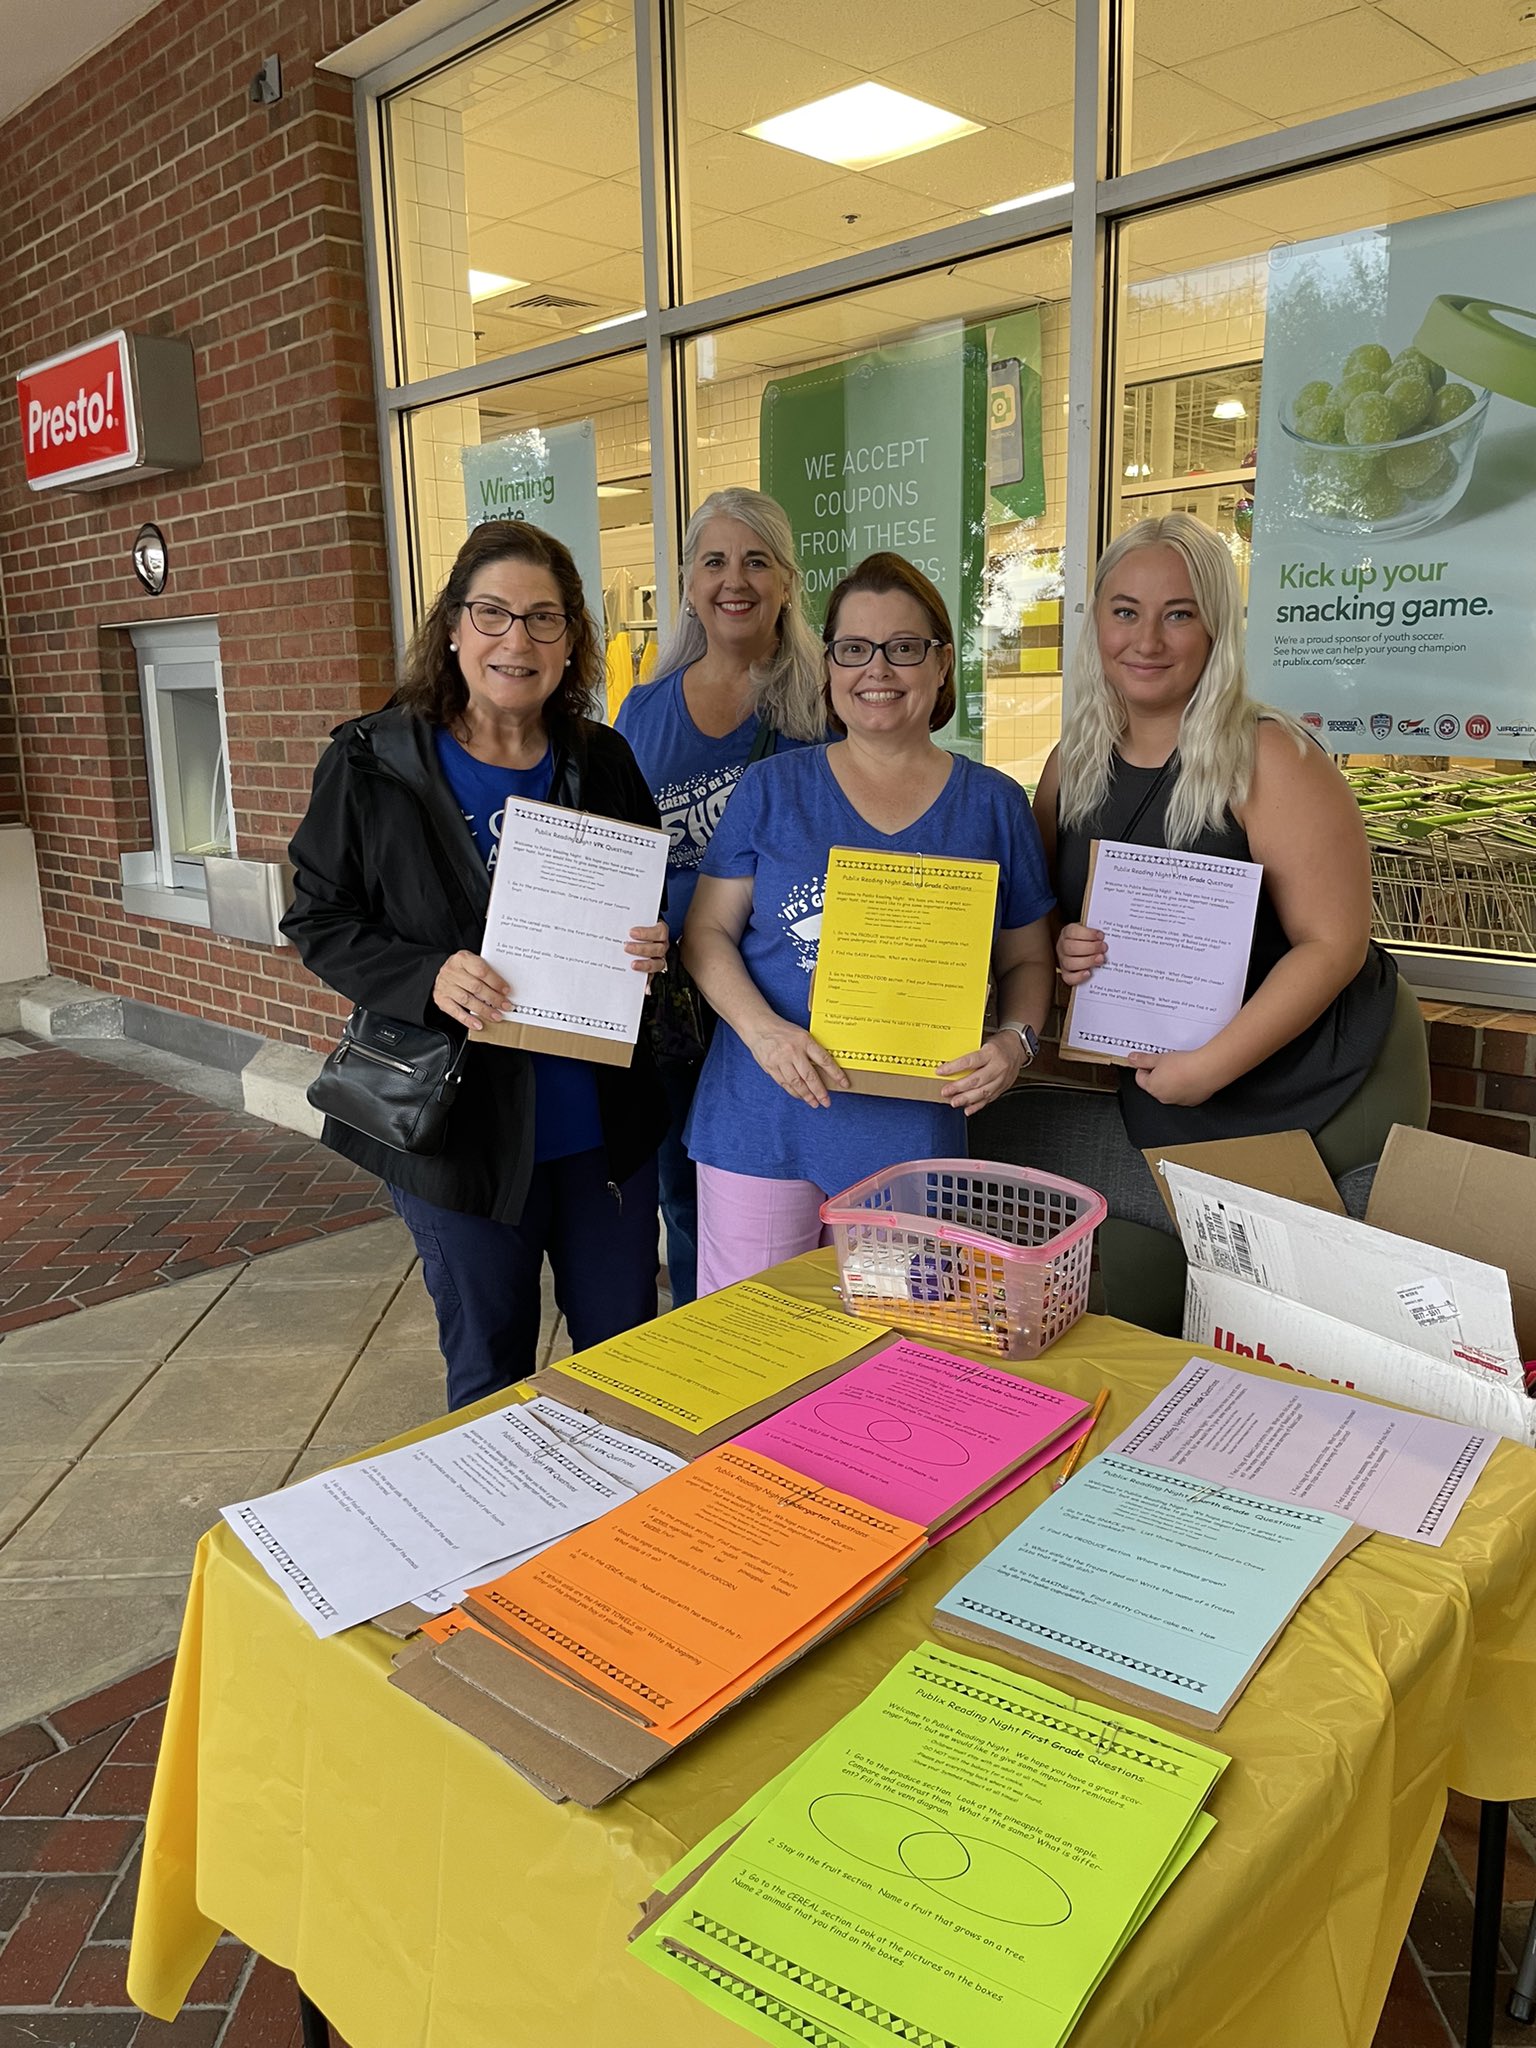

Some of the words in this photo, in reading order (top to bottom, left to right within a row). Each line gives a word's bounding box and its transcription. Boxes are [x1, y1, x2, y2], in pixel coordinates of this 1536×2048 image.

[28, 371, 114, 454] Presto!
[804, 453, 836, 481] WE
[842, 438, 929, 476] ACCEPT
[480, 471, 555, 506] Winning
[815, 480, 919, 517] COUPONS
[800, 527, 857, 556] FROM
[864, 518, 936, 549] THESE
[1280, 562, 1335, 589] Kick
[1341, 565, 1377, 593] up
[1382, 562, 1448, 592] your
[1276, 595, 1395, 627] snacking
[1401, 596, 1493, 626] game.
[1274, 635, 1298, 645] We're
[1307, 635, 1333, 646] proud
[1335, 634, 1371, 646] sponsor
[1372, 633, 1382, 643] of
[1384, 633, 1411, 644] youth
[1412, 632, 1445, 642] soccer.
[1274, 647, 1290, 656] See
[1291, 646, 1310, 655] how
[1325, 647, 1341, 655] can
[1343, 645, 1363, 656] help
[1364, 645, 1386, 656] your
[1387, 644, 1416, 655] young
[1418, 643, 1466, 653] champion
[1272, 659, 1281, 667] at
[1282, 657, 1367, 667] publix.com/soccer.
[658, 793, 691, 811] GREAT
[692, 786, 707, 799] TO
[708, 776, 724, 791] BE
[723, 771, 734, 783] A
[575, 836, 592, 846] ight
[860, 876, 883, 885] Reading
[884, 878, 901, 886] Night
[924, 881, 941, 889] Grade
[942, 883, 972, 891] Questions
[1131, 867, 1154, 877] Reading
[1154, 871, 1171, 879] Night
[1188, 875, 1205, 883] Grade
[1206, 878, 1233, 888] Questions
[783, 898, 809, 921] IT'S
[1003, 1392, 1038, 1407] Questions
[514, 1441, 536, 1457] Reading
[552, 1473, 578, 1492] Questions
[714, 1465, 735, 1478] Publix
[734, 1475, 763, 1491] Reading
[762, 1488, 784, 1501] Night
[830, 1519, 869, 1538] Questions
[1103, 1470, 1128, 1480] Publix
[1129, 1478, 1162, 1491] Reading
[1163, 1488, 1189, 1498] Night
[1188, 1495, 1220, 1508] Furth
[1222, 1505, 1249, 1516] Grade
[1254, 1514, 1301, 1529] Questions
[915, 1688, 946, 1705] Publix
[947, 1701, 987, 1723] Reading
[989, 1717, 1020, 1733] Night
[1021, 1729, 1049, 1744] First
[1051, 1741, 1084, 1758] Grade
[1087, 1755, 1144, 1782] Questions
[841, 1768, 860, 1777] ent?
[859, 1774, 874, 1784] Fill
[882, 1784, 896, 1794] the
[897, 1791, 916, 1801] venn
[916, 1799, 948, 1815] diagram.
[853, 1752, 865, 1761] Go
[875, 1762, 889, 1772] the
[888, 1769, 921, 1784] produce
[922, 1782, 951, 1796] section.
[956, 1794, 976, 1809] Look
[988, 1807, 1002, 1821] the
[1003, 1815, 1043, 1834] pineapple
[1044, 1832, 1062, 1843] and
[1061, 1840, 1072, 1848] an
[1074, 1846, 1097, 1858] apple.
[848, 1760, 880, 1777] Compare
[880, 1775, 897, 1784] and
[896, 1781, 930, 1796] contrast
[931, 1794, 952, 1806] them.
[959, 1805, 981, 1817] What
[991, 1819, 1006, 1829] the
[1007, 1826, 1035, 1840] same?
[1037, 1837, 1060, 1852] What
[1061, 1849, 1071, 1857] is
[1071, 1855, 1102, 1870] differ-
[767, 1837, 775, 1845] 2.
[776, 1841, 796, 1855] Stay
[796, 1850, 805, 1858] in
[805, 1855, 820, 1865] the
[821, 1861, 842, 1874] fruit
[842, 1872, 872, 1890] section.
[877, 1887, 902, 1904] Name
[910, 1903, 932, 1917] fruit
[934, 1914, 954, 1927] that
[953, 1925, 982, 1940] grows
[982, 1938, 995, 1947] on
[1004, 1947, 1024, 1962] tree.
[731, 1877, 754, 1892] Name
[754, 1888, 763, 1896] 2
[762, 1894, 793, 1911] animals
[793, 1908, 812, 1920] that
[811, 1918, 828, 1929] you
[829, 1925, 849, 1938] find
[848, 1936, 860, 1944] on
[861, 1941, 876, 1952] the
[877, 1948, 904, 1966] boxes.
